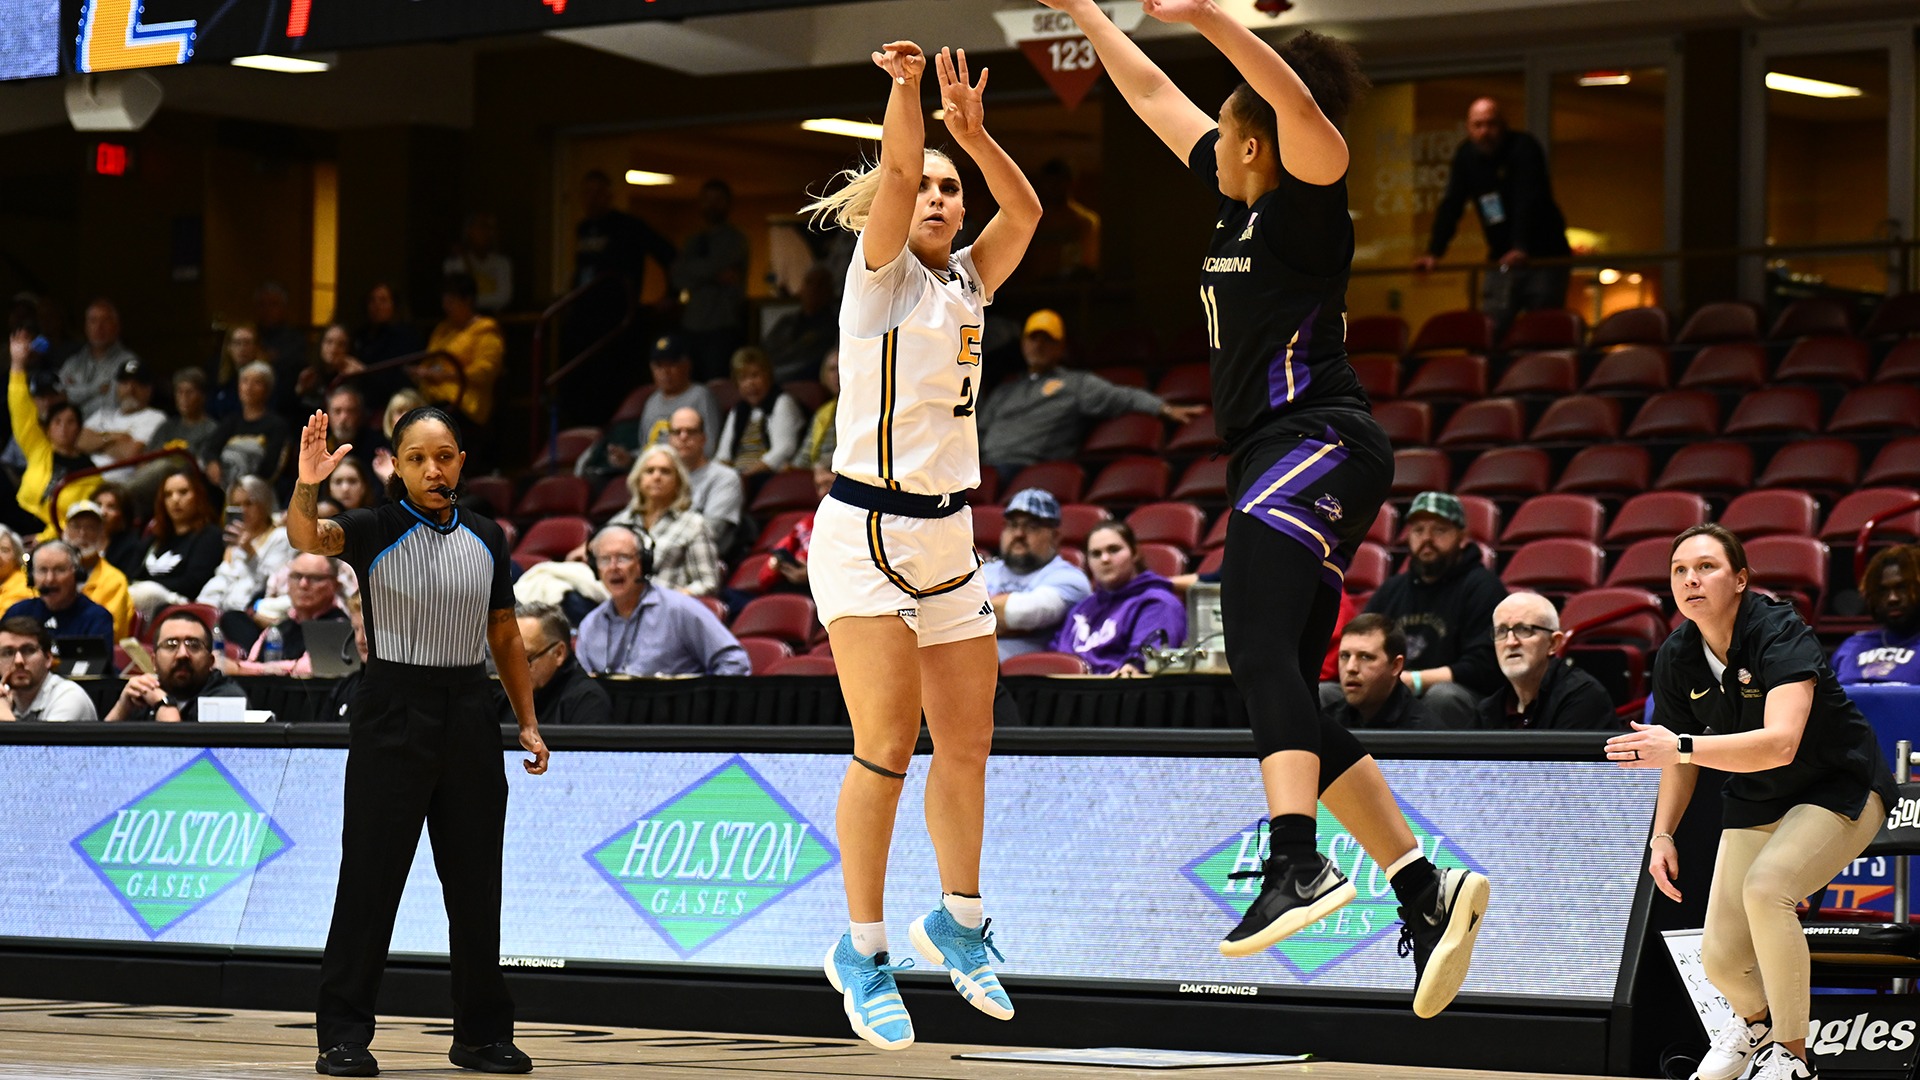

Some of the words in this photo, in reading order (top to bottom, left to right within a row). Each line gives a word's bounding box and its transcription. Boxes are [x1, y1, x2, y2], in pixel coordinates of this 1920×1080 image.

[1048, 39, 1097, 71] 123
[1205, 257, 1251, 272] CAROLINA
[1200, 285, 1220, 349] 11
[1857, 646, 1915, 666] WCU
[100, 809, 266, 866] HOLSTON
[619, 820, 811, 881] HOLSTON
[126, 872, 209, 899] GASES
[651, 888, 748, 915] GASES
[499, 956, 565, 968] DAKTRONICS
[1179, 983, 1258, 996] DAKTRONICS
